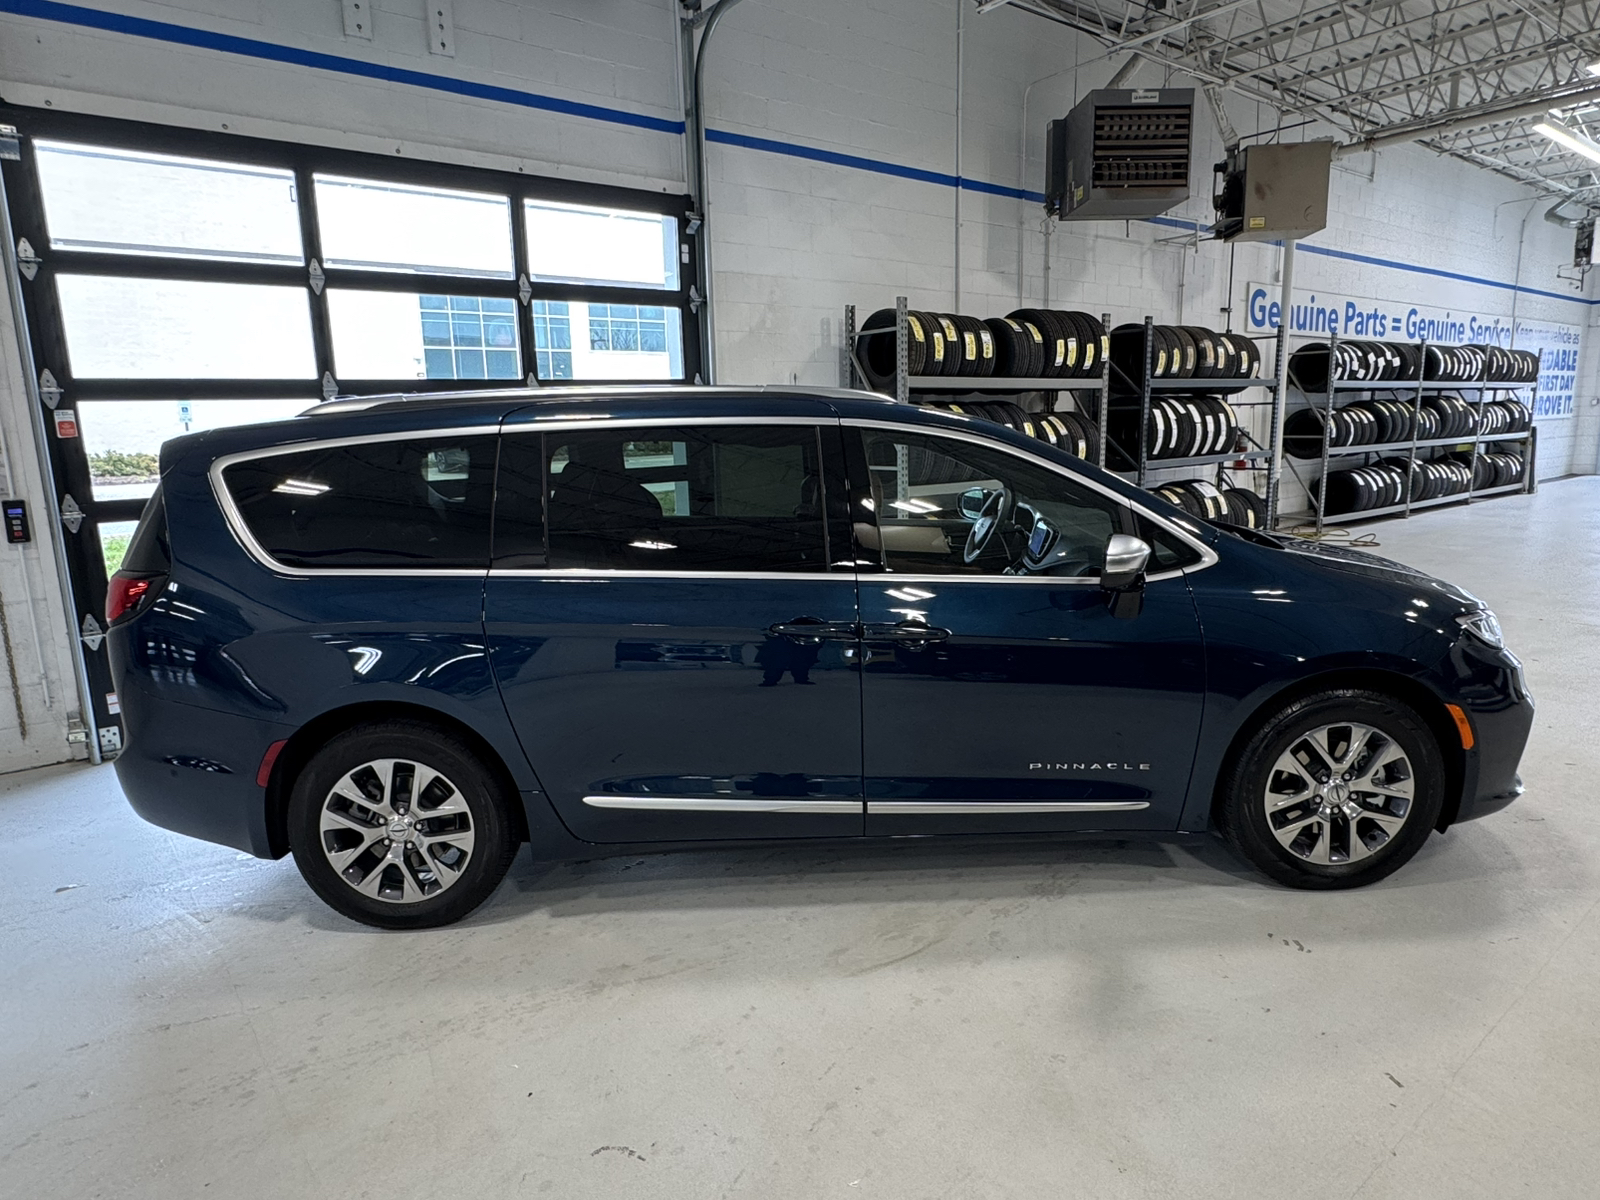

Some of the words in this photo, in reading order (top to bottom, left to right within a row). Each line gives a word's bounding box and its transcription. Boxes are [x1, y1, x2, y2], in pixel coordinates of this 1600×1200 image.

[1344, 301, 1387, 337] Parts
[1391, 317, 1402, 331] =
[1406, 308, 1466, 343] Genuine
[1538, 375, 1559, 391] FIRST
[1559, 375, 1576, 391] DAY
[1563, 395, 1574, 414] IT.
[1028, 762, 1151, 771] PINNACLE
